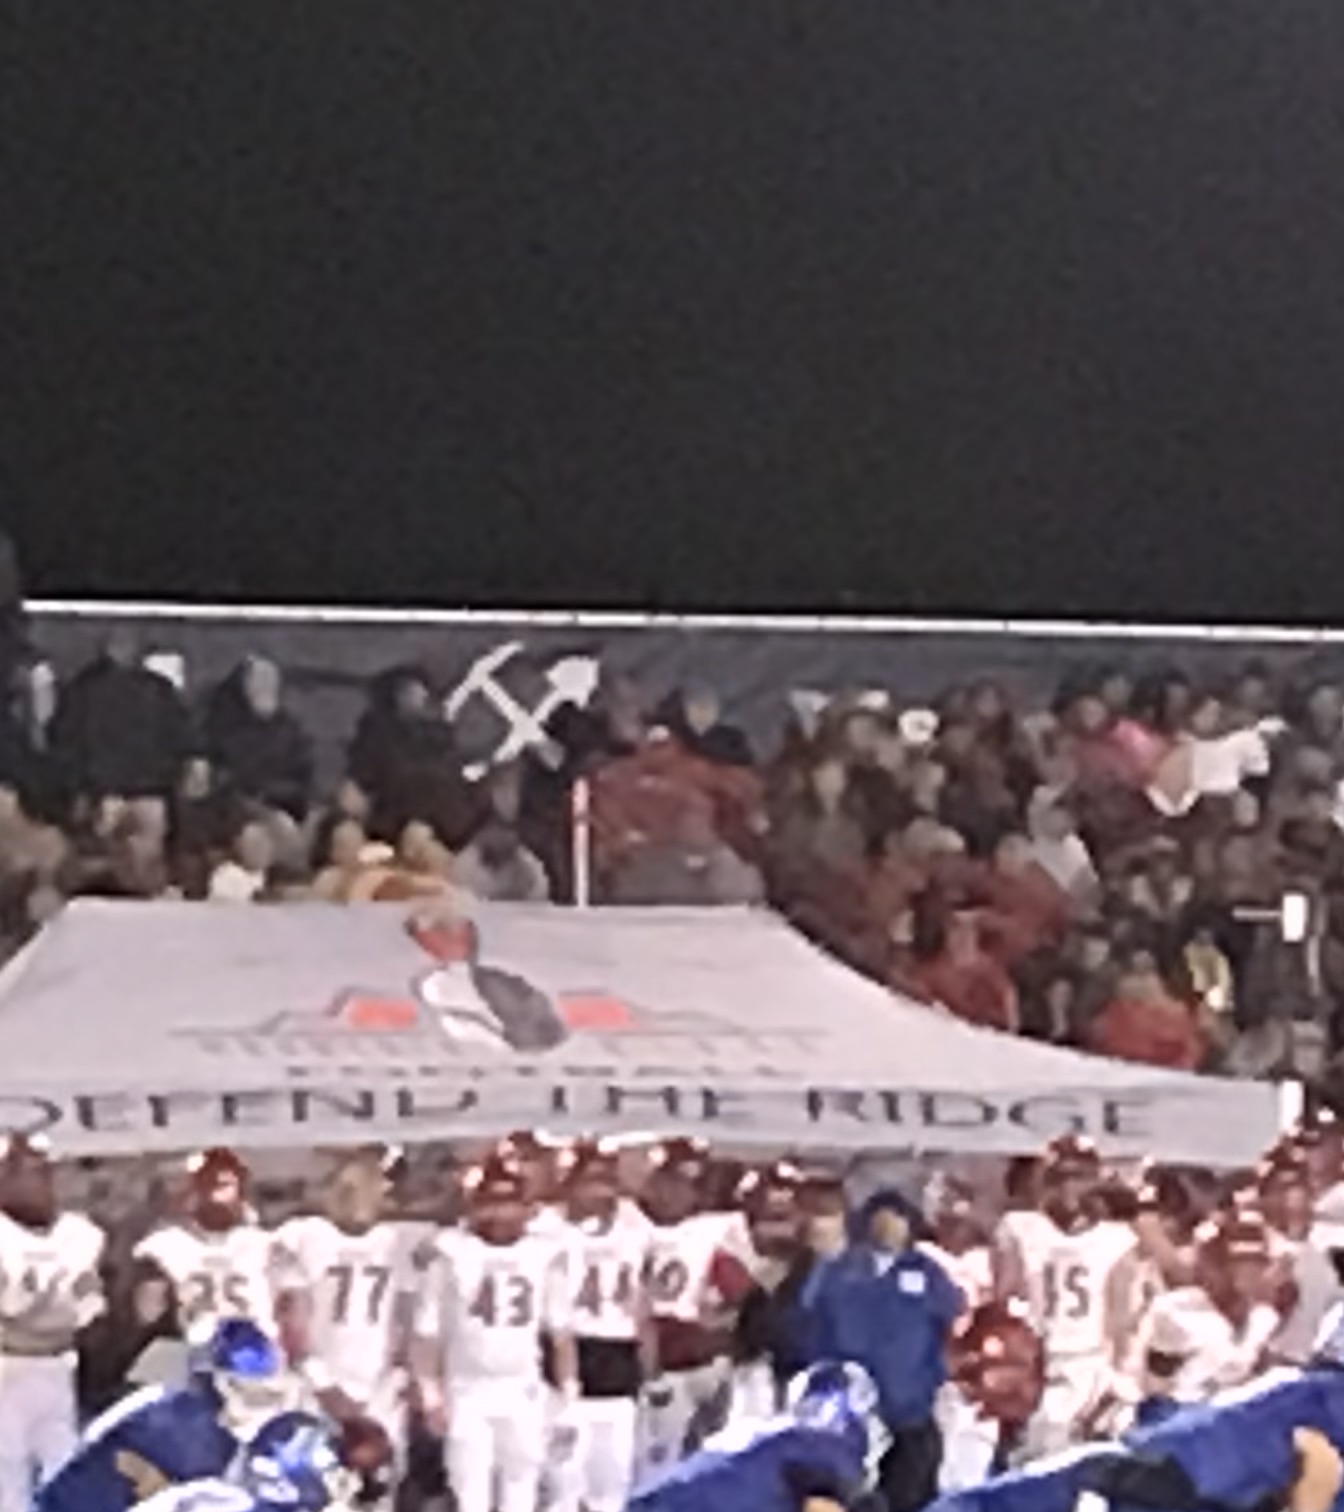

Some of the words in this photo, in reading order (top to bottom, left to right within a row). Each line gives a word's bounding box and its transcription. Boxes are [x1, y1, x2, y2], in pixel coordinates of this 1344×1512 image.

[805, 1086, 1162, 1137] RIDGE
[326, 1264, 391, 1325] 77
[468, 1273, 535, 1329] 43
